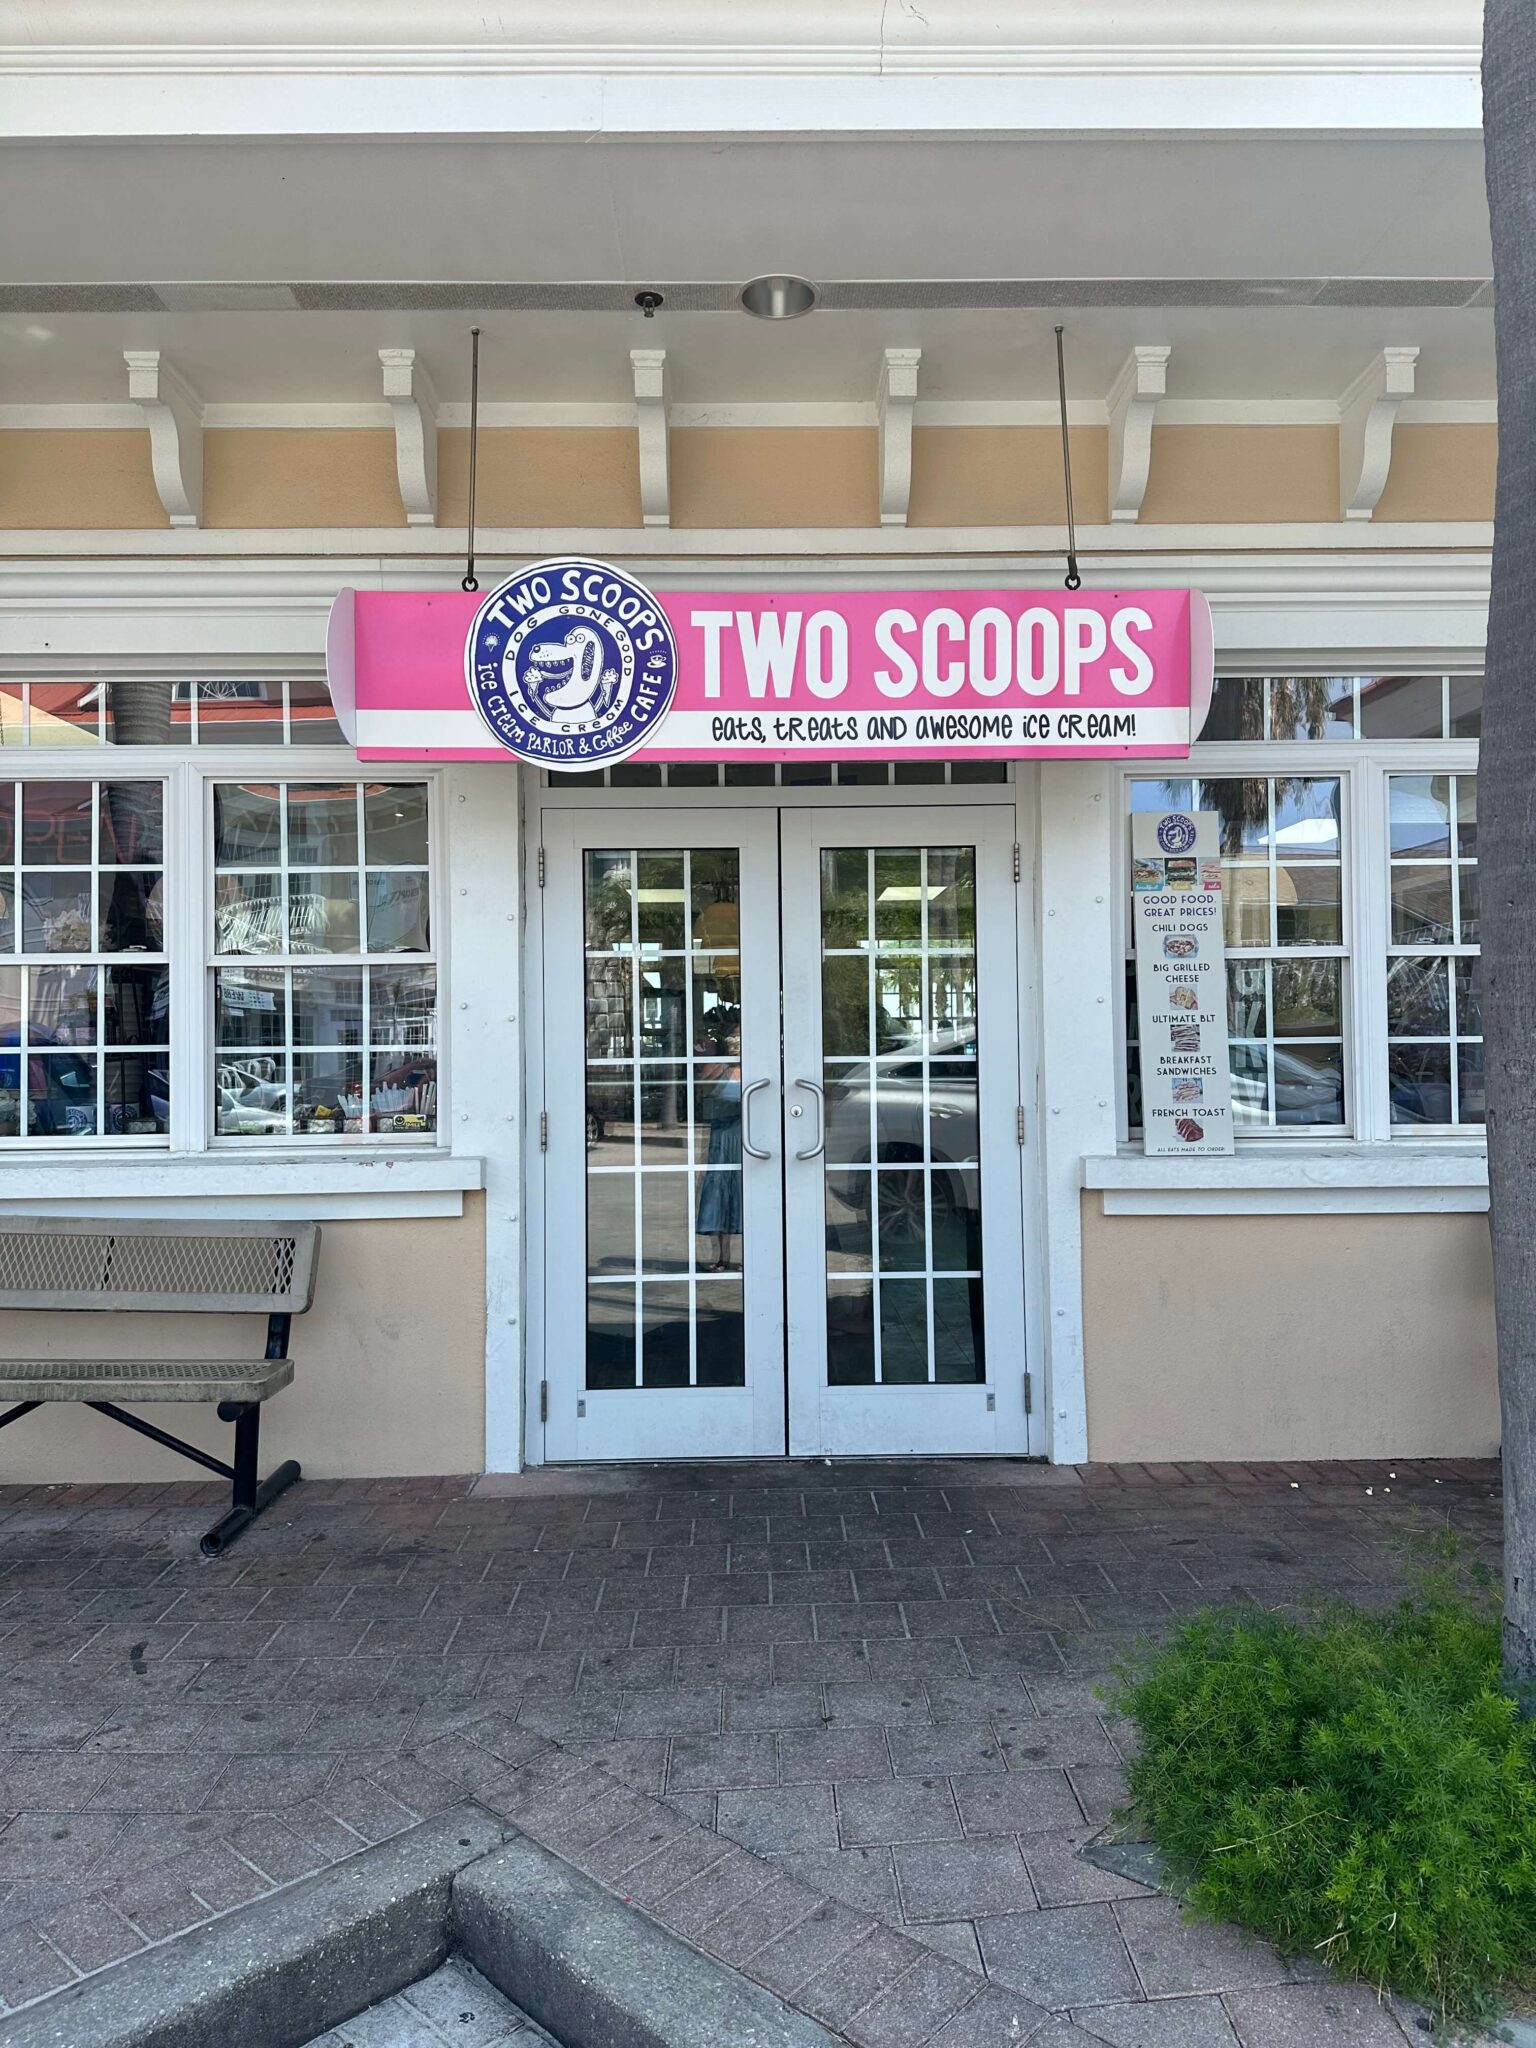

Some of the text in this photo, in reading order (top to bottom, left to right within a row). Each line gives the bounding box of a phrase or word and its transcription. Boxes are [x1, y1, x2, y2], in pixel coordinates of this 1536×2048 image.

[487, 569, 665, 651] TWO SCOOPS
[505, 606, 633, 677] DOG GONE GOOD
[690, 606, 1155, 699] TWO SCOOPS
[509, 690, 539, 726] ICE
[526, 732, 576, 756] PARLOR
[578, 736, 593, 755] &
[592, 720, 634, 751] Coffee
[630, 671, 662, 722] CAFE
[711, 716, 767, 743] eats,
[1022, 713, 1050, 739] ice
[1143, 895, 1177, 905] GOOD
[1144, 907, 1217, 917] GREAT PRICES!
[1152, 923, 1209, 932] CHILI DOGS
[1153, 963, 1211, 972] BIG GRILLED
[1165, 974, 1200, 983] CHEESE
[1152, 1014, 1216, 1023] ULTIMATE BLT
[1160, 1056, 1213, 1065] BREAKFAST
[1156, 1067, 1217, 1076] SANDWICHES
[1152, 1108, 1226, 1117] FRENCH TOAST
